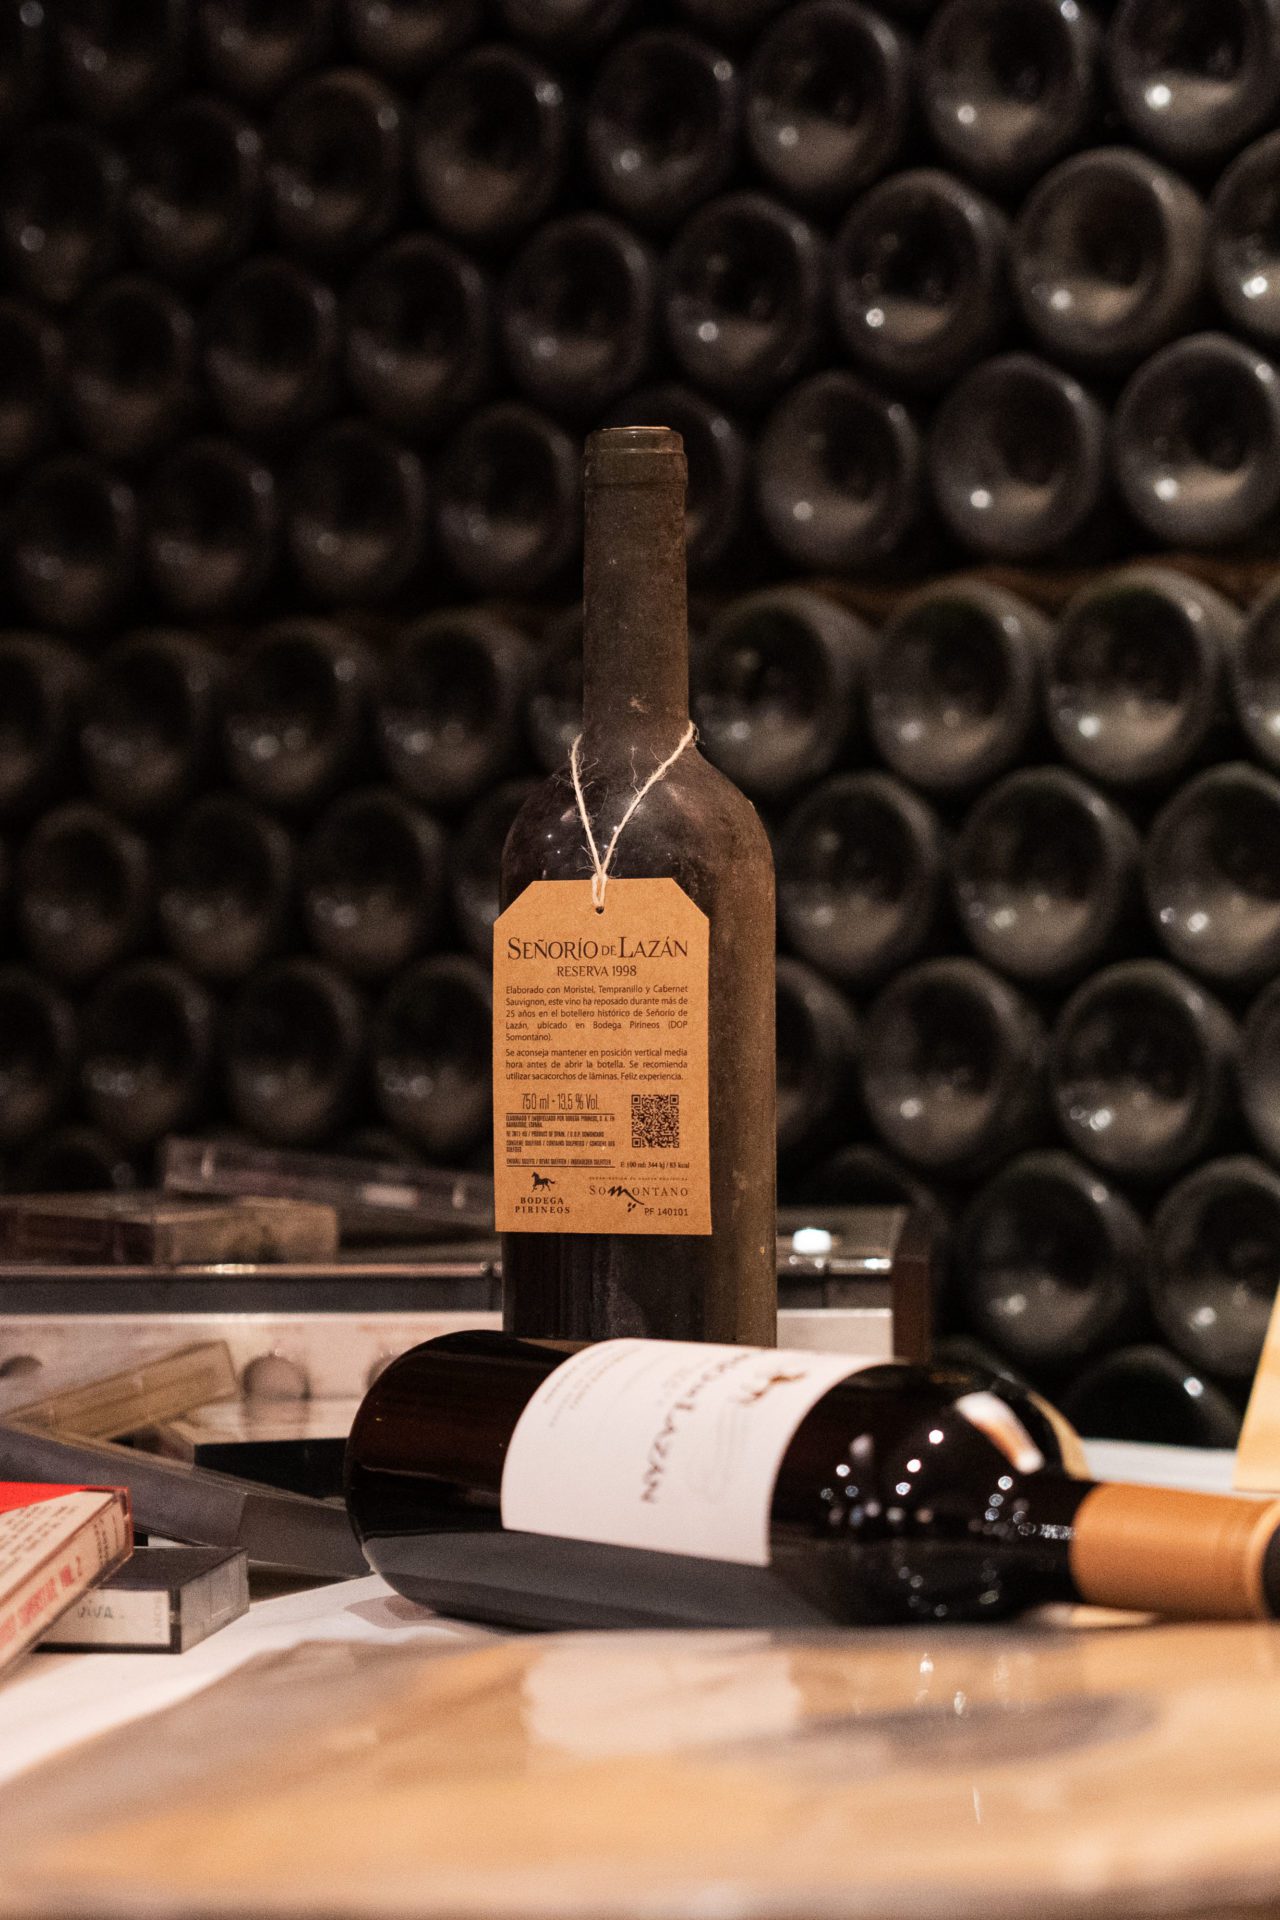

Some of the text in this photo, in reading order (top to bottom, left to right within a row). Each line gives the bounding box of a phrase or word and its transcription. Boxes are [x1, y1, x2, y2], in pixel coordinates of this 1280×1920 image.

[508, 936, 687, 961] SEÑORÍO DE LAZÁN
[557, 965, 637, 977] RESERVA 1998
[506, 986, 544, 995] Elaborado
[599, 985, 642, 995] Tempranillo
[653, 985, 688, 993] Cabernet
[506, 998, 546, 1008] Sauvignon,
[565, 998, 581, 1006] vino
[583, 998, 592, 1006] ha
[594, 997, 628, 1007] reposado
[630, 998, 659, 1006] durante
[662, 997, 676, 1005] más
[678, 997, 688, 1005] de
[506, 1010, 515, 1018] 25
[518, 1010, 535, 1018] años
[561, 1009, 594, 1018] botellero
[598, 1010, 630, 1018] histórico
[633, 1009, 642, 1017] de
[678, 1009, 688, 1017] de
[538, 1021, 567, 1030] ubicado
[593, 1021, 621, 1031] Bodega
[630, 1021, 659, 1030] Pirineos
[668, 1021, 687, 1030] (DOP
[506, 1049, 514, 1057] Se
[517, 1049, 548, 1058] aconseja
[601, 1049, 632, 1059] posición
[635, 1048, 661, 1057] vertical
[664, 1048, 687, 1057] media
[506, 1060, 522, 1069] hora
[551, 1061, 560, 1069] de
[565, 1060, 582, 1069] abrir
[630, 1060, 638, 1069] Se
[643, 1060, 687, 1069] recomienda
[506, 1072, 530, 1081] utilizar
[532, 1072, 576, 1081] sacacorchos
[578, 1072, 587, 1081] de
[621, 1072, 637, 1081] Feliz
[639, 1074, 683, 1082] experiencia.
[589, 1185, 689, 1205] SOMONTANO
[521, 1197, 563, 1205] BODEGA
[515, 1206, 570, 1214] PIRINEOS
[658, 1208, 688, 1216] 140101
